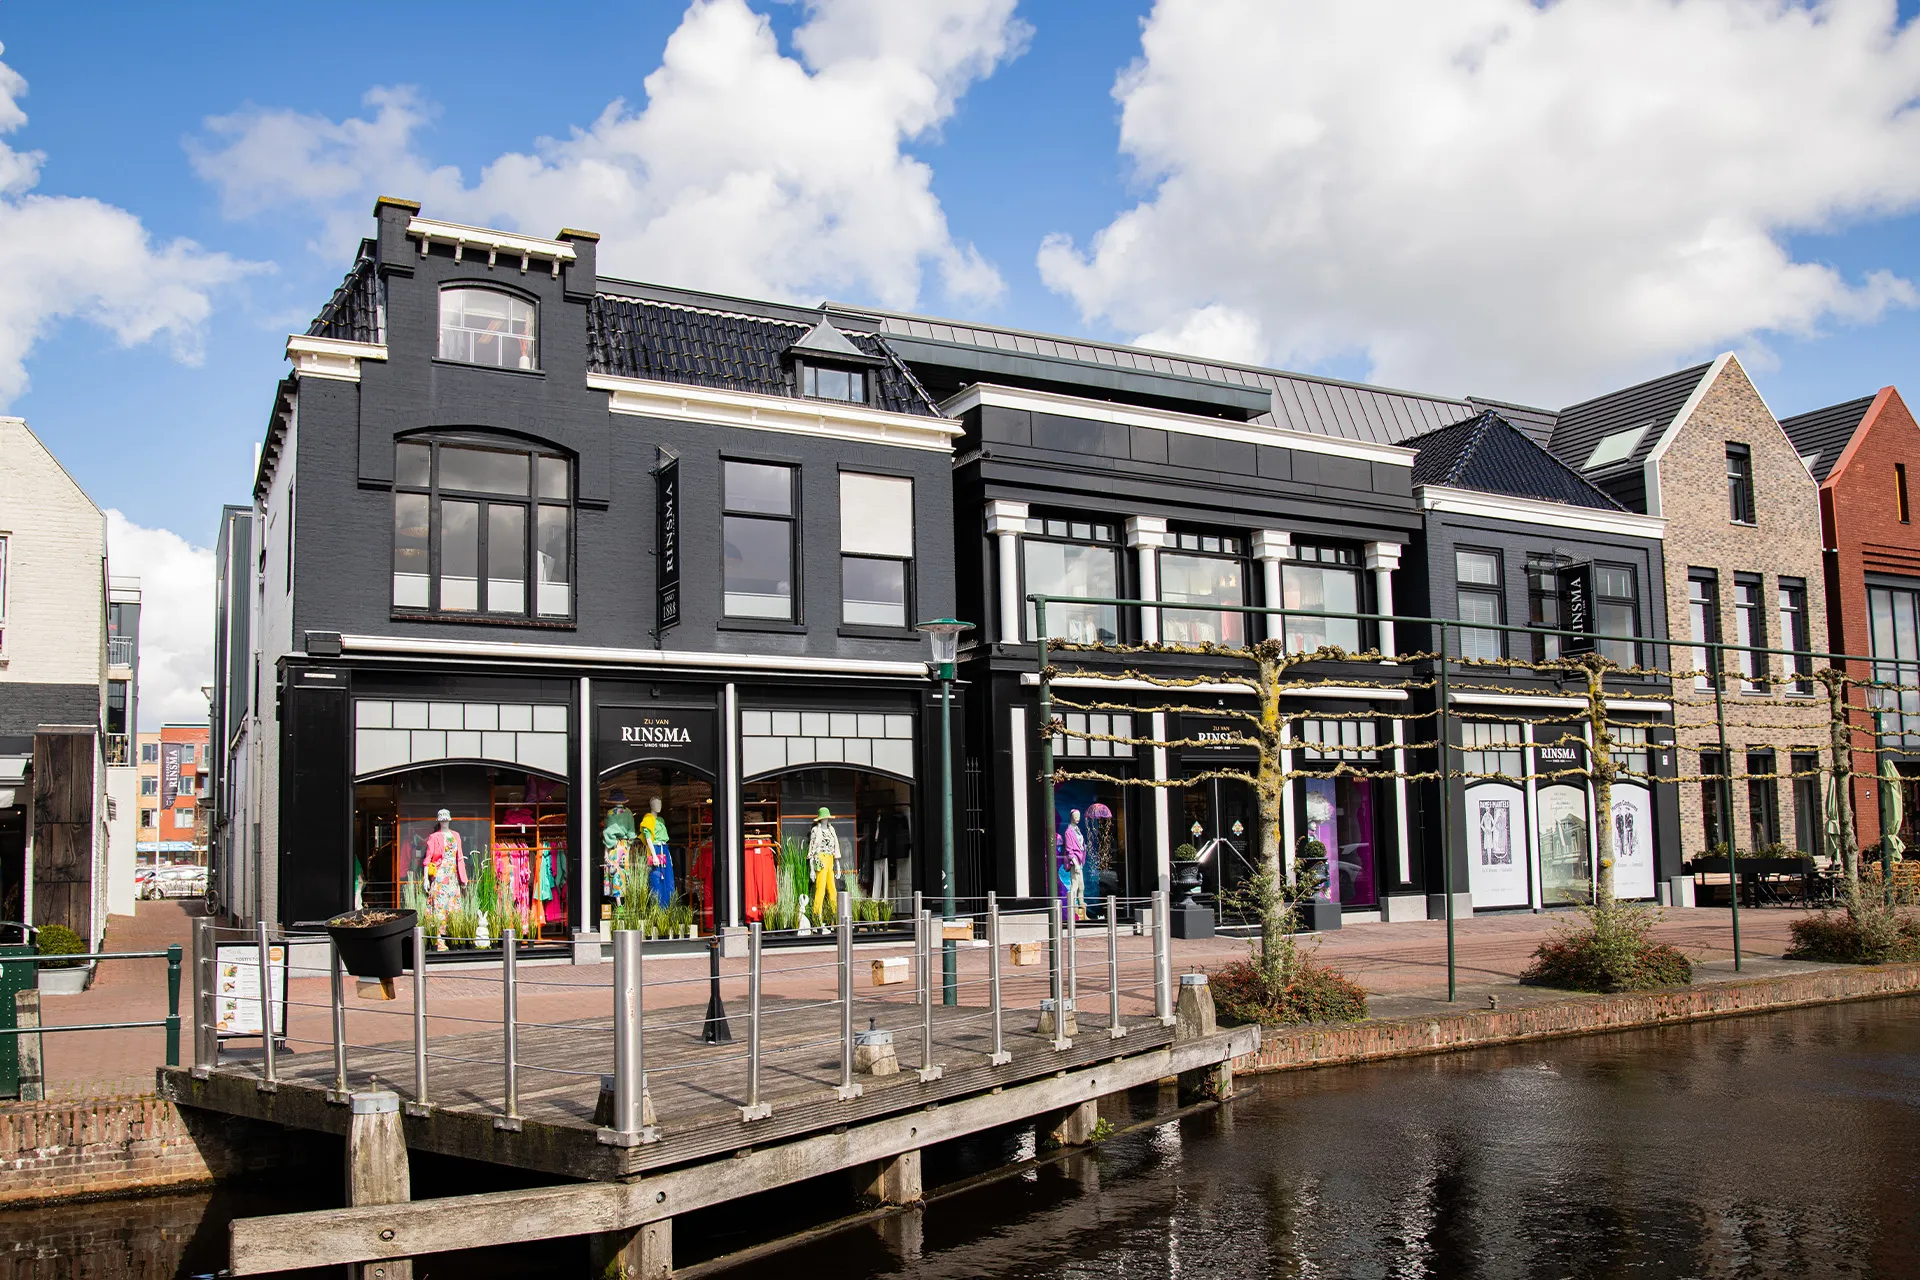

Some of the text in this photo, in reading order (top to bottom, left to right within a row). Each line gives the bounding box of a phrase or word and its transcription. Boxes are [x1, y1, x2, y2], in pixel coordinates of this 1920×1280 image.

[666, 481, 674, 574] RINSMA
[663, 601, 676, 618] 1888
[621, 726, 692, 742] RINSMA
[1541, 748, 1577, 759] RINSMA
[169, 749, 178, 788] RINSMA
